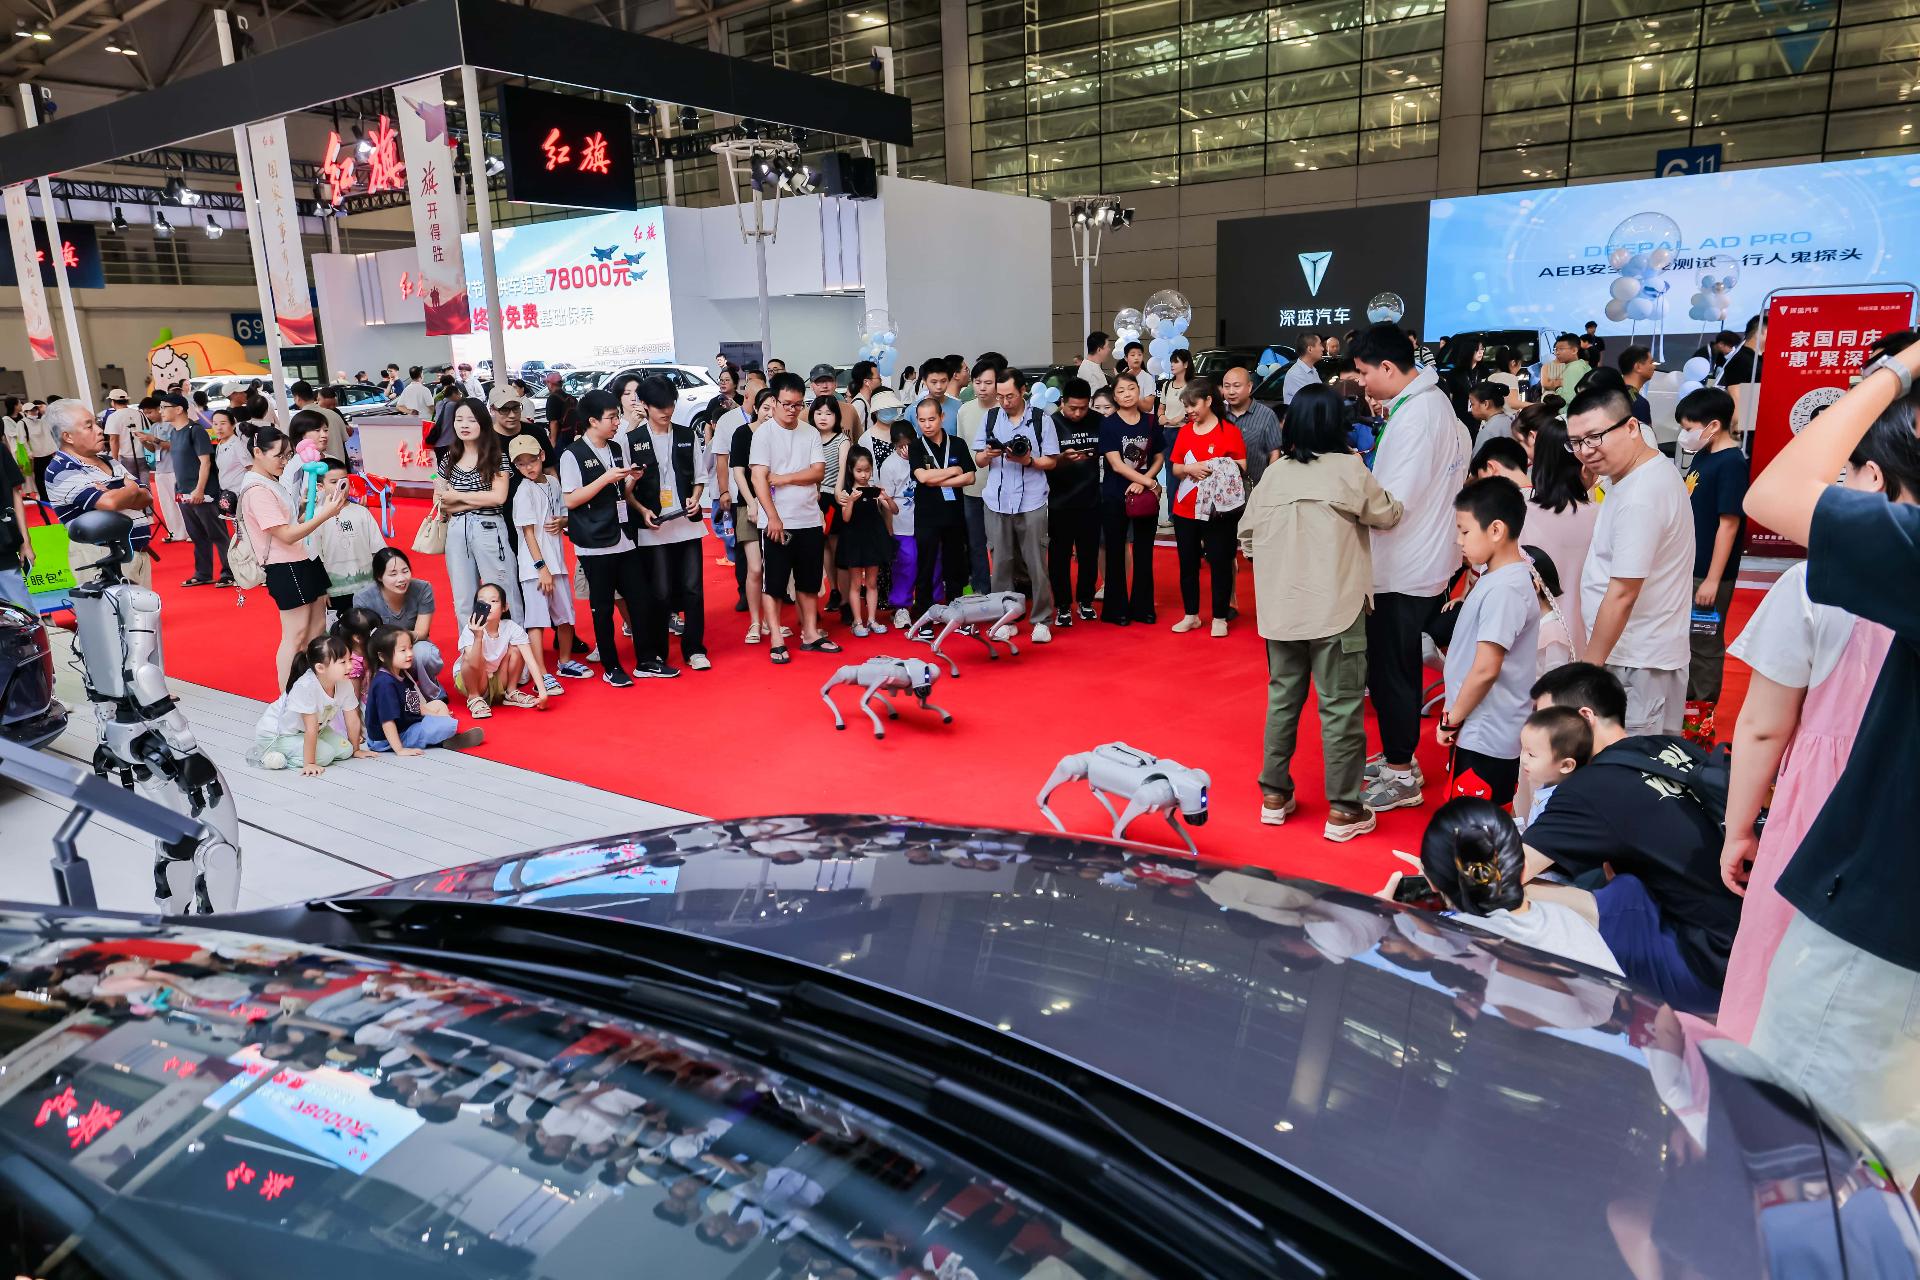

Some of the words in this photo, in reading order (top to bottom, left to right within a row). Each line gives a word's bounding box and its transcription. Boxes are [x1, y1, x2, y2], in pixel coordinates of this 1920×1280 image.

[324, 113, 406, 207] 红旗
[542, 128, 612, 174] 红旗
[421, 161, 444, 263] 旗开得胜
[633, 223, 657, 242] 红旗
[1699, 236, 1741, 250] AD
[1750, 231, 1813, 246] PRO
[1280, 307, 1351, 327] 深蓝汽车
[1790, 329, 1883, 348] 家国同庆
[398, 440, 434, 469] 红旗
